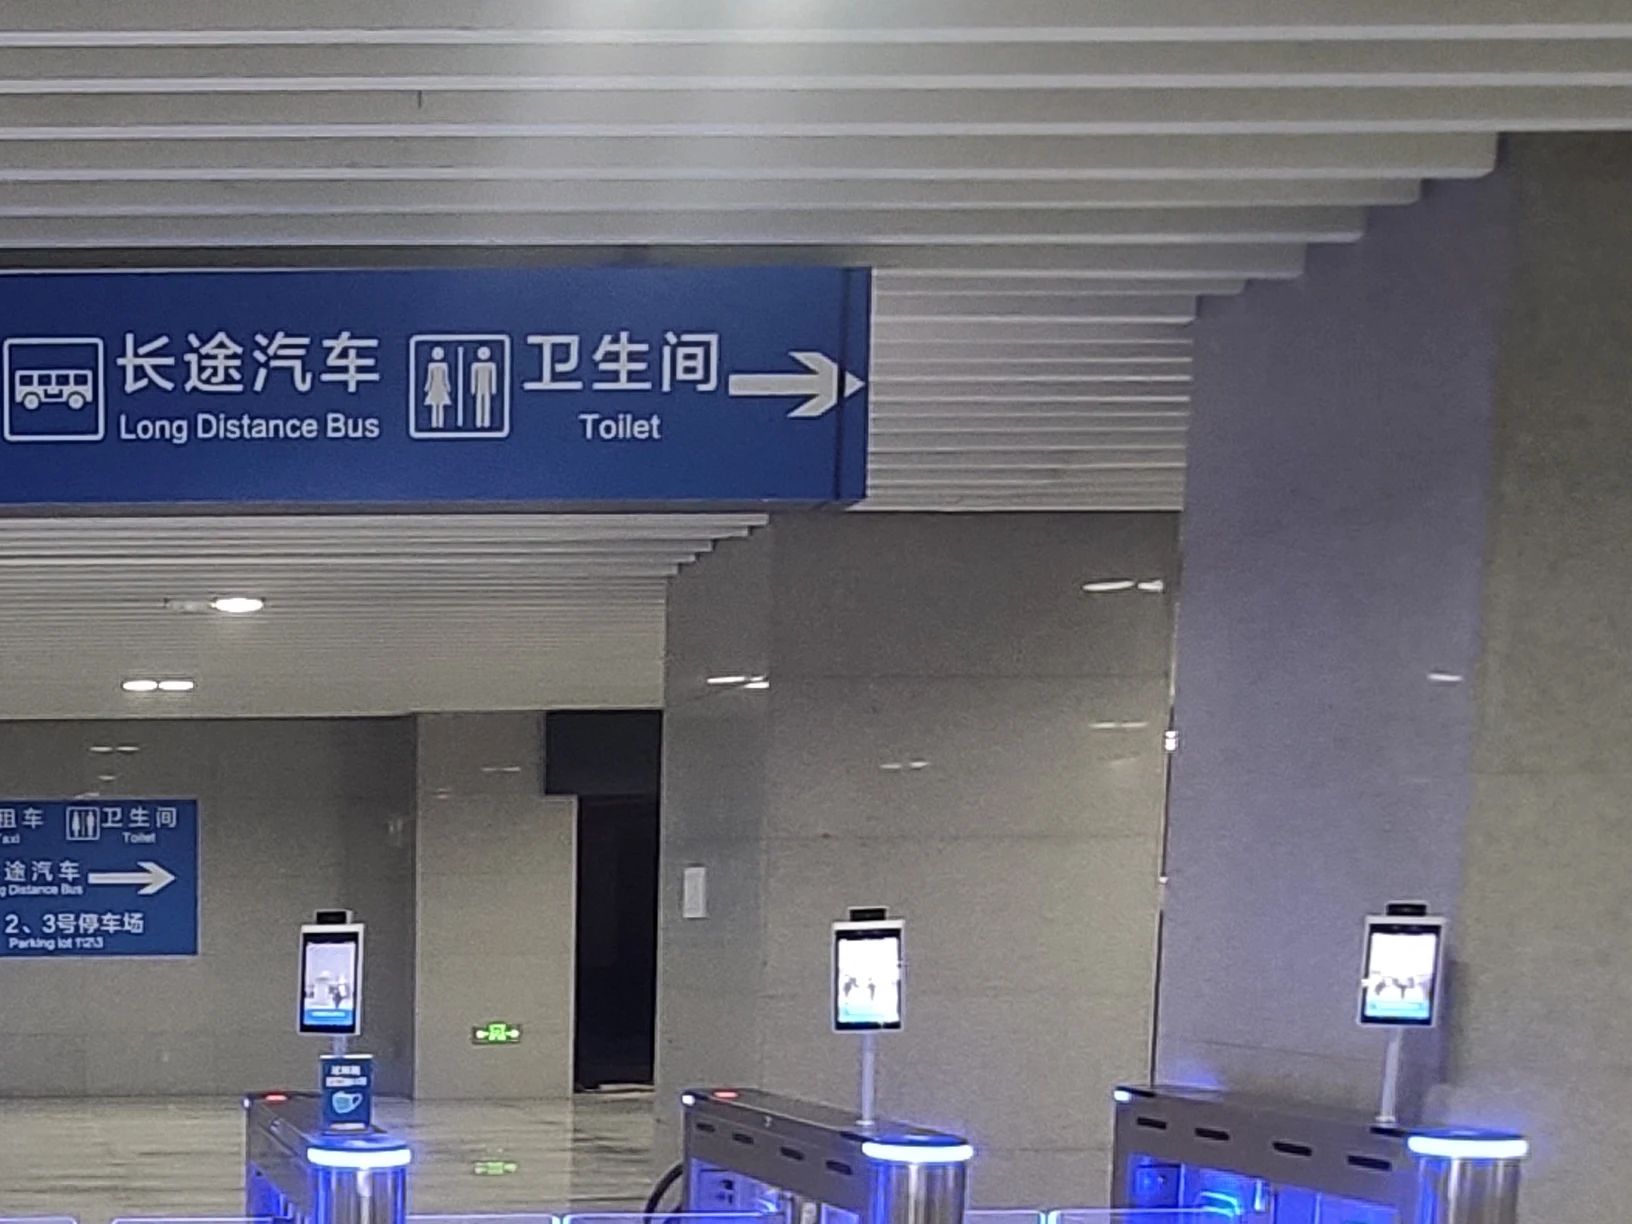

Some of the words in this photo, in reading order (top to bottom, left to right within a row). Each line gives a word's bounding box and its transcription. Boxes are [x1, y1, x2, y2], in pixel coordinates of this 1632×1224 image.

[117, 332, 379, 393] 长途汽车
[523, 332, 718, 392] 卫生间
[120, 415, 187, 443] Long
[198, 414, 317, 438] Distance
[327, 413, 379, 437] Bus
[579, 414, 660, 439] Toilet
[102, 806, 176, 827] 卫生间
[123, 832, 155, 843] Toilet
[9, 885, 58, 895] Distance
[61, 884, 83, 894] Bus
